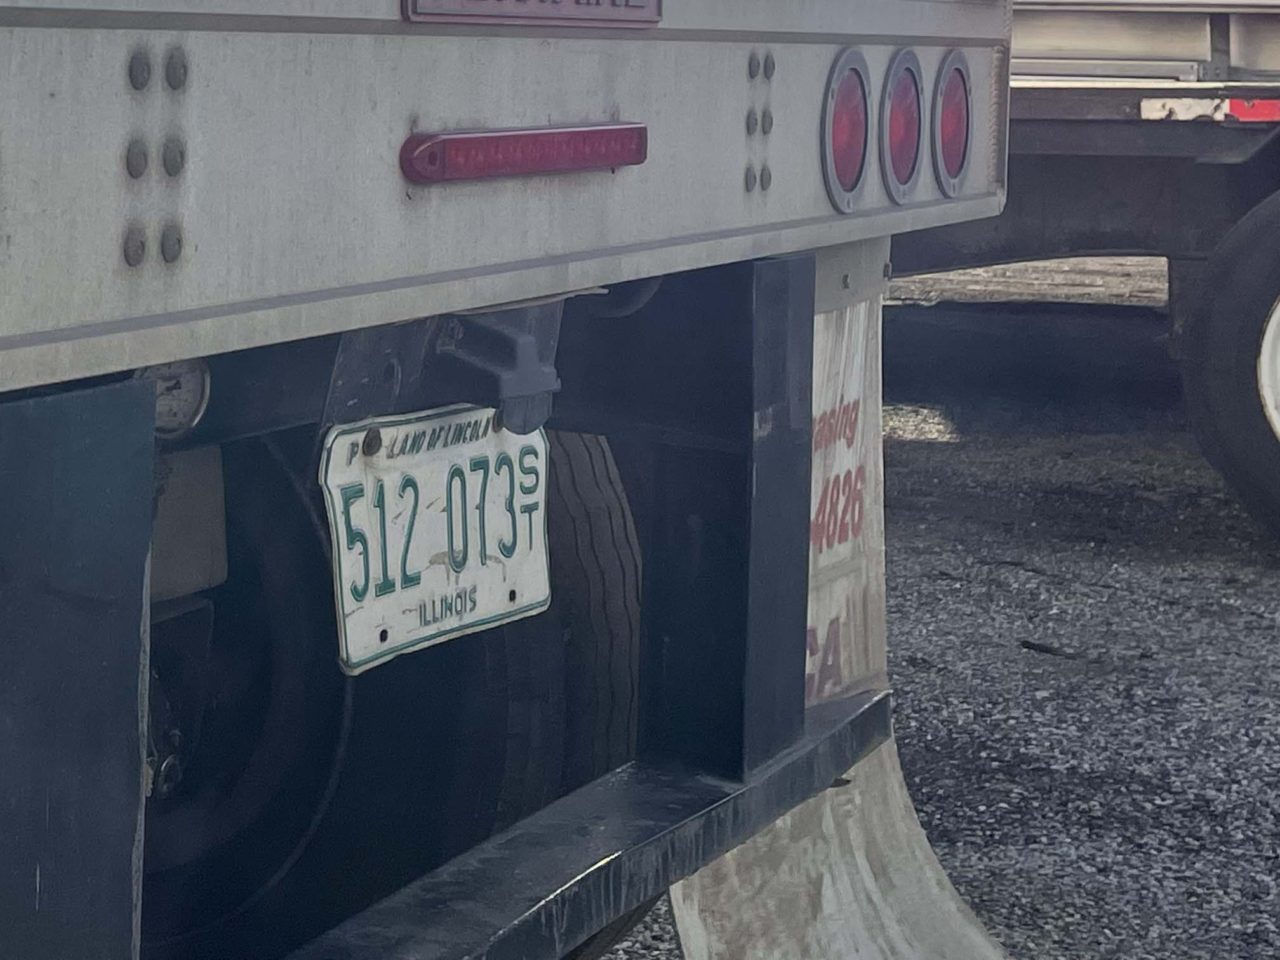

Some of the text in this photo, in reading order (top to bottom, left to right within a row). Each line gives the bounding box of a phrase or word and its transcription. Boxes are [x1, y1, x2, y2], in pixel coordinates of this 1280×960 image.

[386, 415, 493, 459] LAND OF LINCOLN
[813, 397, 861, 453] asing
[340, 451, 518, 603] 512 073
[419, 587, 478, 628] ILLINOIS
